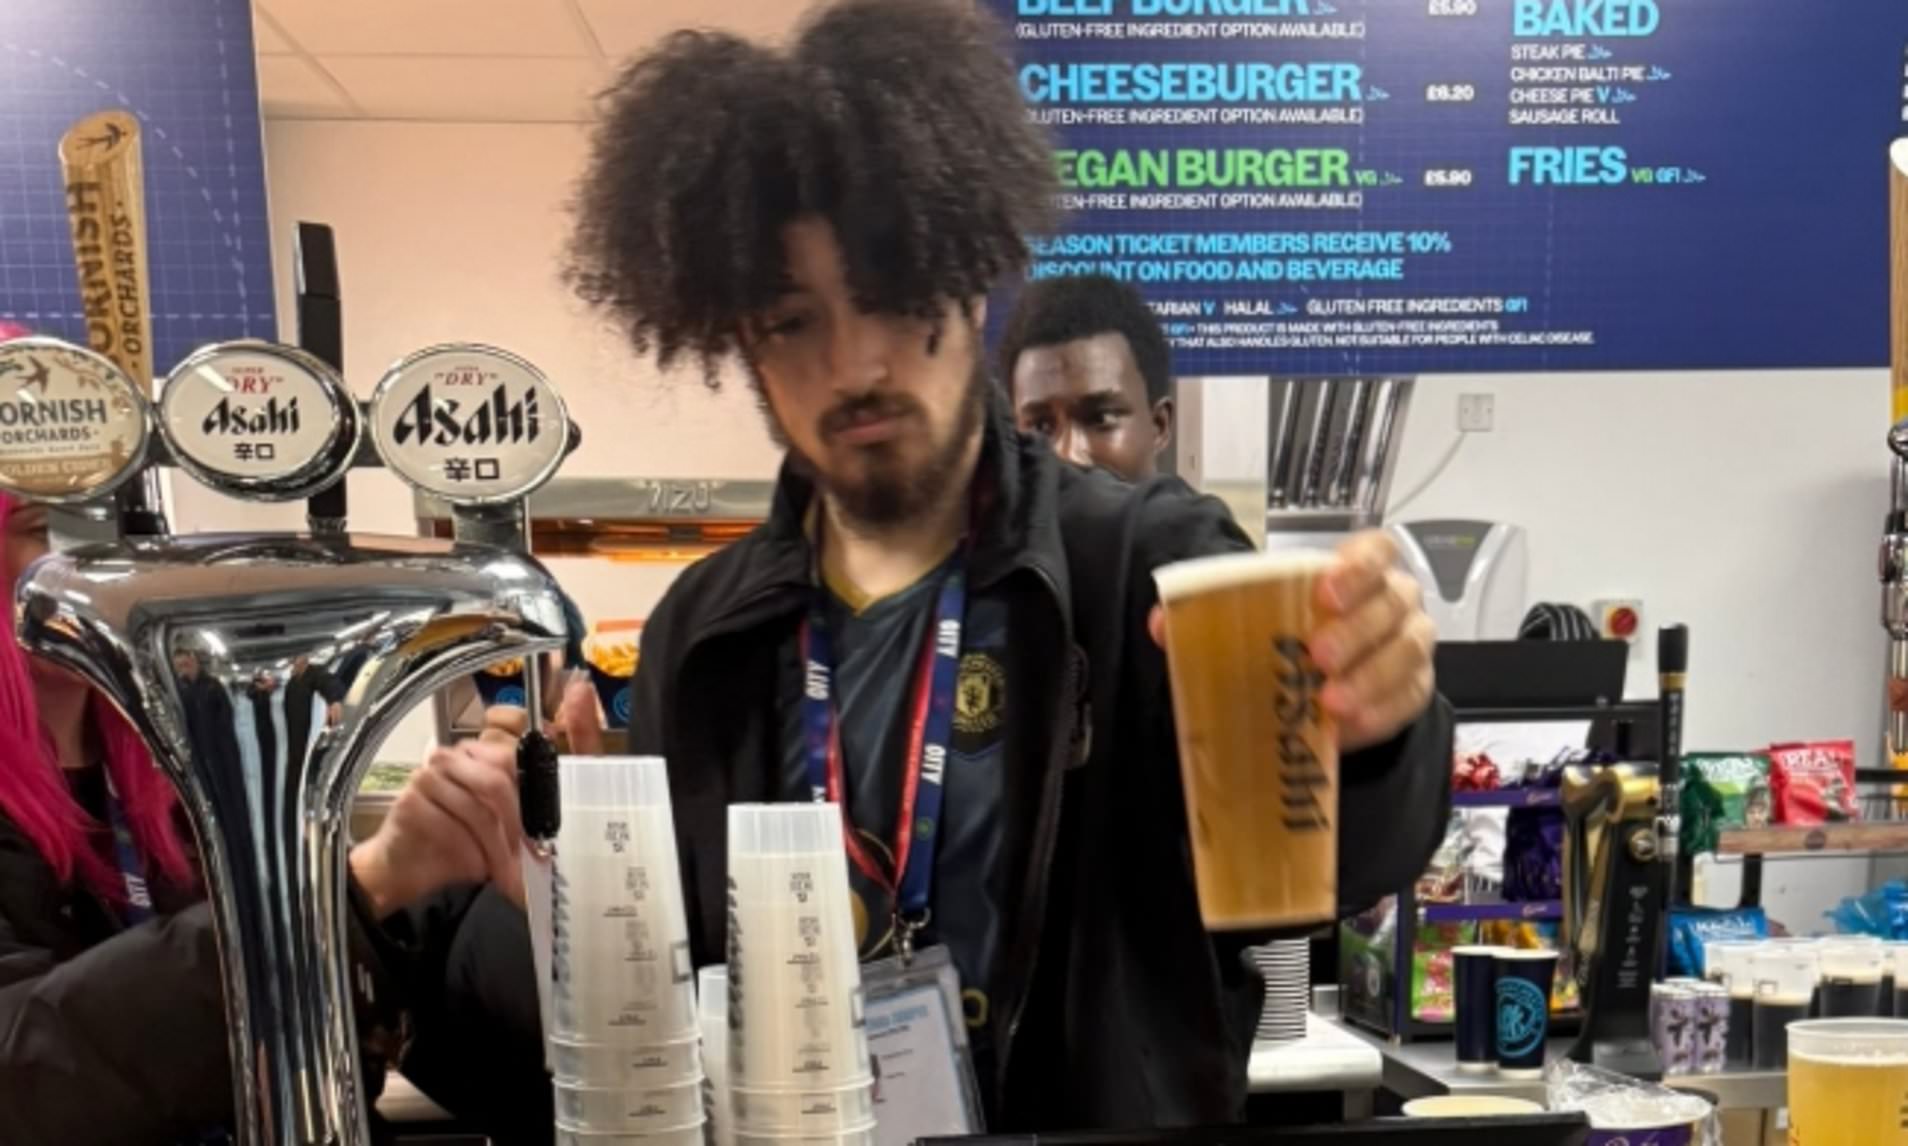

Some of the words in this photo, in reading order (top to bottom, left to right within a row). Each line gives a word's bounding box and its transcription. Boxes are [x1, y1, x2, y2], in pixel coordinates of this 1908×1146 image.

[1513, 0, 1660, 36] BAKED
[1127, 22, 1218, 38] INGREDIENT
[1220, 22, 1275, 38] OPTION
[1510, 45, 1560, 59] STEAK
[1562, 45, 1586, 59] PIE
[1019, 64, 1361, 101] CHEESEBURGER
[1510, 67, 1576, 81] CHICKEN
[1578, 67, 1618, 81] BALTI
[1621, 67, 1645, 81] PIE
[1509, 88, 1567, 103] CHEESE
[1570, 88, 1595, 103] PIE
[1596, 86, 1610, 103] V
[1027, 108, 1125, 124] LUTEN-FREE
[1129, 108, 1217, 124] INGREDIENT
[1220, 108, 1275, 124] OPTION
[1509, 109, 1577, 124] SAUSAGE
[1581, 109, 1619, 124] ROLL
[1055, 150, 1168, 187] EGAN
[1177, 149, 1349, 186] BURGER
[1509, 147, 1626, 184] FRIES
[1129, 193, 1217, 209] INGREDIENT
[1220, 193, 1275, 209] OPTION
[1115, 234, 1195, 254] TICKET
[1197, 233, 1309, 254] MEMBERS
[1313, 232, 1404, 253] RECEIVE
[1406, 232, 1452, 252] 10%
[1138, 260, 1171, 281] ON
[1174, 260, 1232, 280] FOOD
[1235, 260, 1284, 280] AND
[1286, 259, 1403, 279] BEVERAGE
[1223, 299, 1275, 315] HALAL
[1306, 299, 1366, 315] GLUTEN
[1367, 299, 1403, 313] FREE
[1406, 298, 1502, 313] INGREDIENTS
[0, 399, 107, 425] ORNISH
[202, 396, 300, 434] Asahi
[393, 383, 539, 445] Asahi
[234, 442, 275, 461] 辛口
[444, 458, 499, 481] 辛口
[937, 619, 960, 657] CITY
[921, 744, 946, 784] CITY
